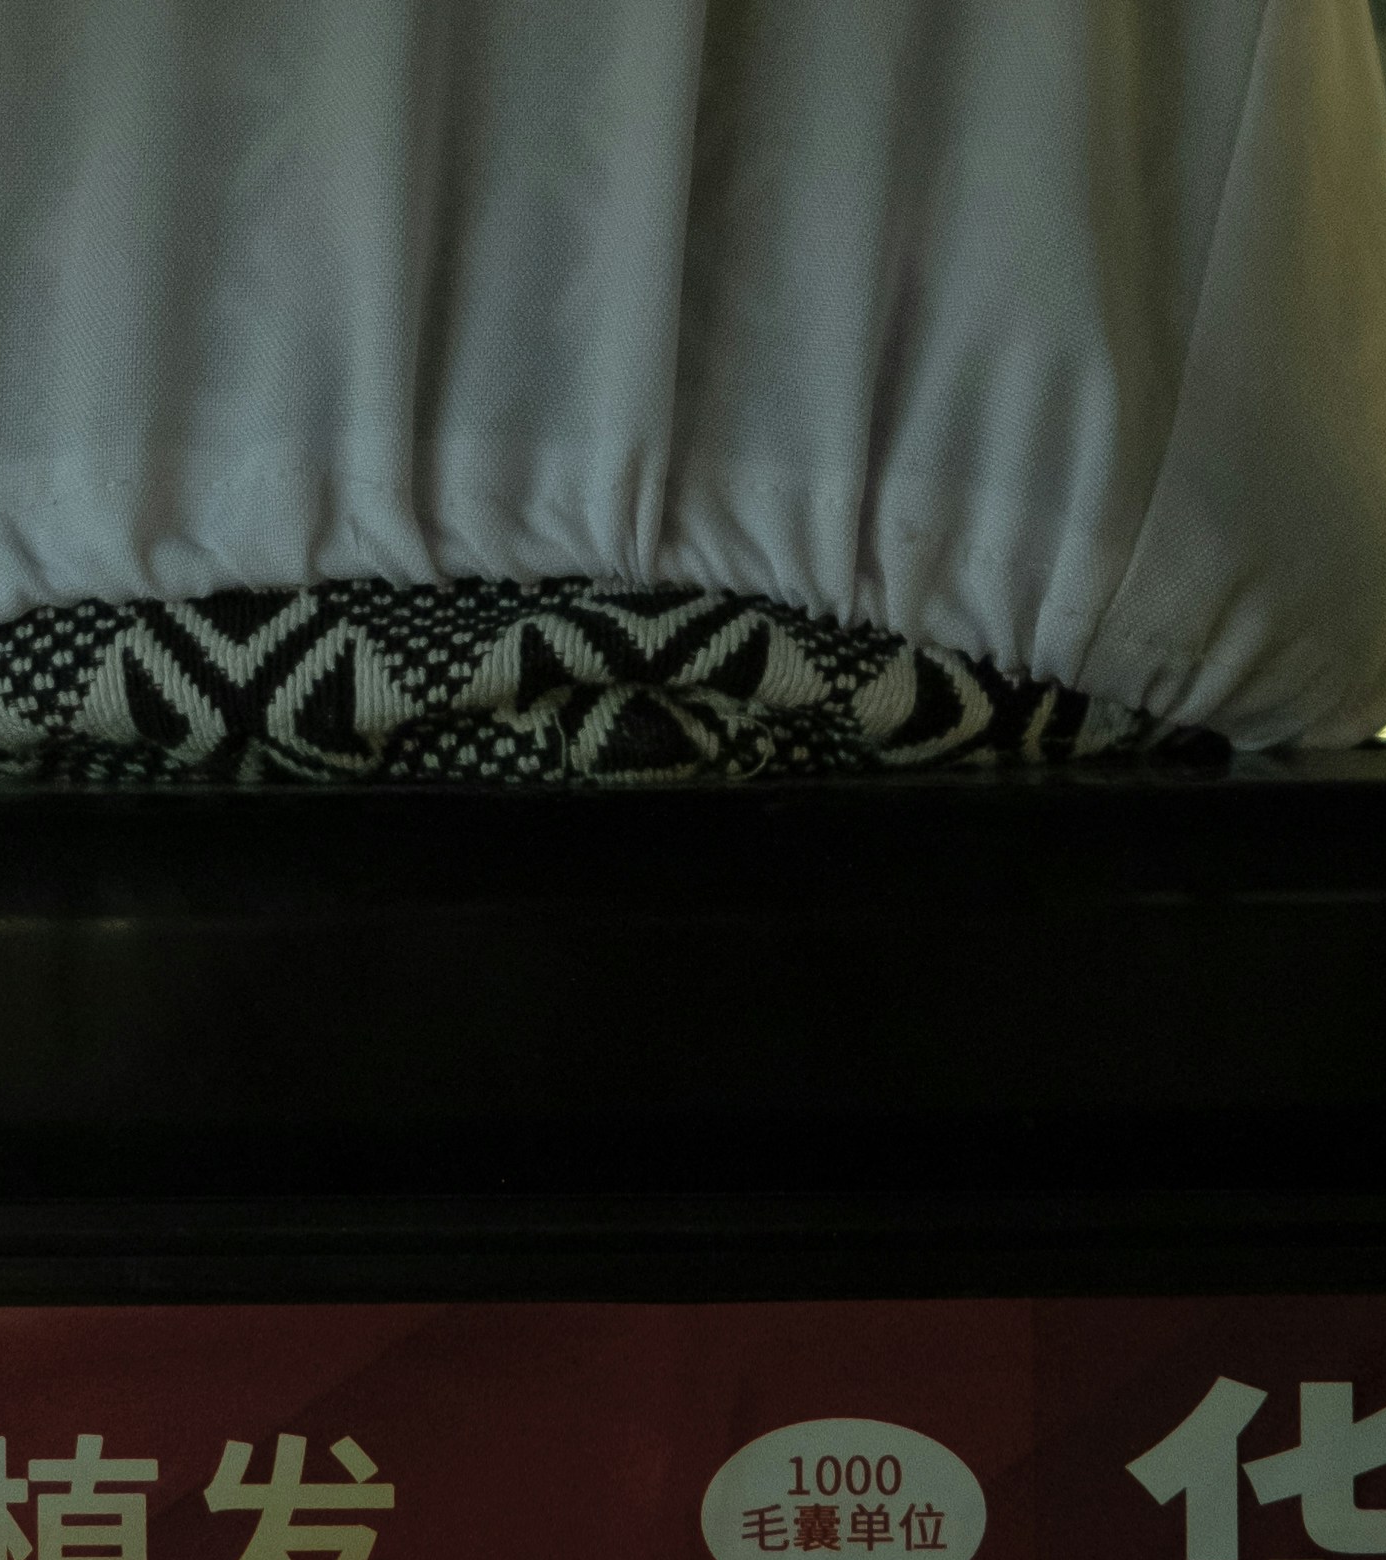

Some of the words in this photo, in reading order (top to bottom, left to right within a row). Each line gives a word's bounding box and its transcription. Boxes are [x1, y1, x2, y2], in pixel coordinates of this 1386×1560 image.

[786, 1453, 902, 1497] 1000
[740, 1502, 948, 1552] 毛囊单位
